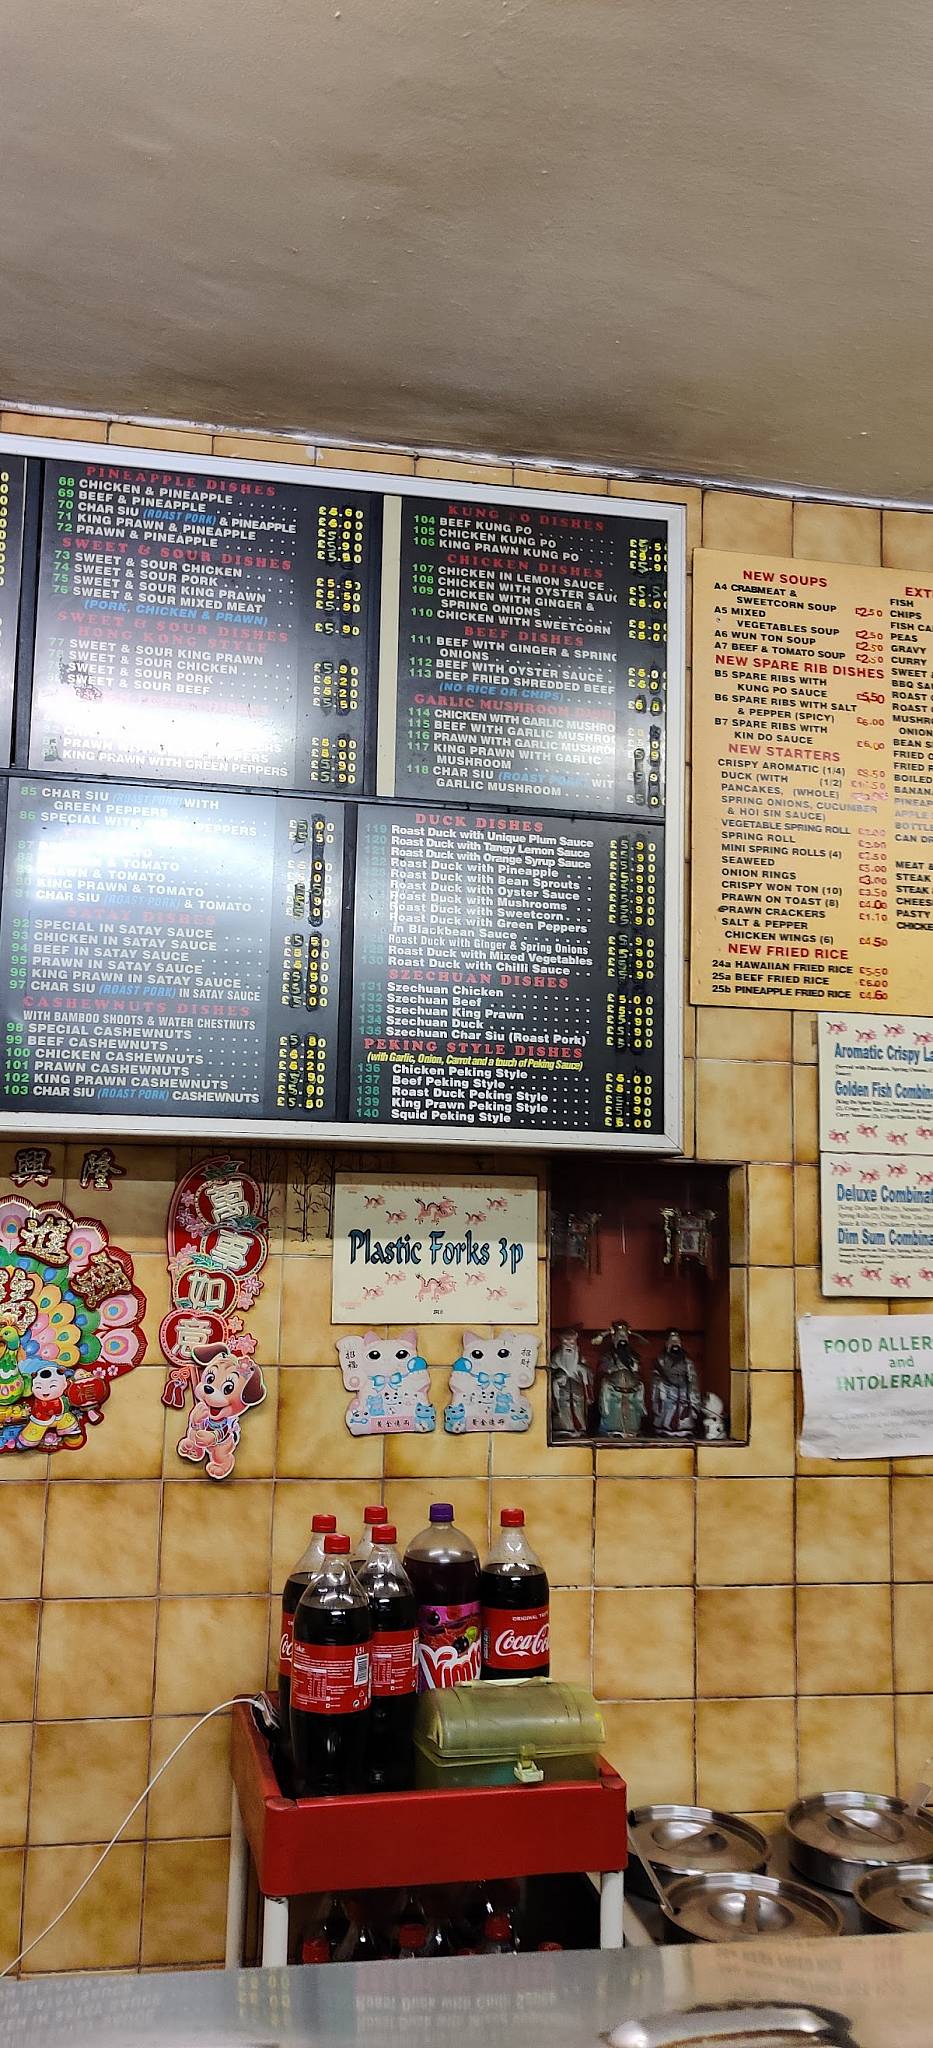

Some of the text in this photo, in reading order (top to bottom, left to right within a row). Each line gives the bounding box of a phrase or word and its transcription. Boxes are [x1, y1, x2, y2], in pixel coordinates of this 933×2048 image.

[85, 466, 275, 496] PINEAPPLE DISHES
[59, 477, 233, 505] 68 CHICKEN & PINEAPPLE
[58, 511, 256, 540] 71 KING PRAWN & PINEAPPLE
[414, 514, 532, 536] 104 BEEF KUNG PO
[63, 537, 291, 571] SWEET & SOUR DISHES
[414, 536, 579, 562] 106 KING PRAWN KUNG PO
[55, 551, 242, 577] 73 SWEET & SOUR CHICKEN
[447, 554, 603, 579] CHICKEN DISHES
[412, 563, 604, 591] 107 CHICKEN IN LEMON SAUCE
[743, 570, 827, 588] NEW SOUPS
[905, 586, 933, 598] EXT
[890, 598, 914, 608] FISH
[890, 610, 922, 620] CHIPS
[464, 626, 583, 647] BEEF DISHES
[715, 630, 816, 645] A6 WUN TON SOUP
[891, 633, 918, 642] PEAS
[714, 642, 728, 650] A7
[732, 643, 758, 652] BEEF
[772, 646, 814, 657] TOMATO
[818, 650, 846, 659] SOUP
[891, 645, 926, 654] GRAVY
[409, 656, 603, 683] 112 BEEF WITH OYSTER SAUCE
[716, 655, 884, 679] NEW SPARE RIB DISHES
[891, 657, 926, 666] CURRY
[416, 814, 543, 832] DUCK DISHES
[392, 825, 594, 848] Roast Duck with Unique Plum Sauce
[722, 831, 794, 843] SPRING ROLL
[722, 856, 775, 866] SEAWEED
[722, 869, 796, 880] ONION RINGS
[35, 919, 93, 932] SPECIAL
[99, 923, 114, 933] IN
[119, 924, 162, 936] SATAY
[167, 927, 213, 939] SAUCE
[728, 944, 848, 960] NEW FRIED RICE
[389, 969, 569, 988] SZECHUAN DISHES
[712, 973, 829, 984] 25a BEEF FRIED RICE
[387, 982, 448, 994] Szechuan
[452, 985, 503, 997] Chicken
[23, 996, 250, 1016] CASHEWNUTS DISHES
[23, 1010, 255, 1030] WITH BAMBOO SHOOTS & WATER CHESTNUTS
[6, 1022, 192, 1039] 98 SPECIAL CASHEWNUTS
[6, 1035, 168, 1051] 99 BEEF CASHEWNUTS
[364, 1039, 583, 1058] PEKING STYLE DISHES
[835, 1042, 883, 1060] Aromatic
[887, 1045, 920, 1065] Crispy
[6, 1060, 189, 1076] 101 PRAWN CASHEWNUTS
[392, 1064, 444, 1075] Chicken
[449, 1067, 491, 1079] Peking
[496, 1069, 528, 1081] Style
[835, 1080, 869, 1097] Golden
[872, 1081, 892, 1098] Fish
[391, 1109, 427, 1122] Squid
[432, 1111, 474, 1123] Peking
[479, 1113, 511, 1125] Style
[837, 1183, 877, 1202] Deluxe
[838, 1228, 858, 1245] Dim
[862, 1229, 885, 1245] Sum
[348, 1228, 524, 1274] Plastic Forks 3p
[824, 1338, 873, 1354] FOOD
[889, 1355, 915, 1369] and
